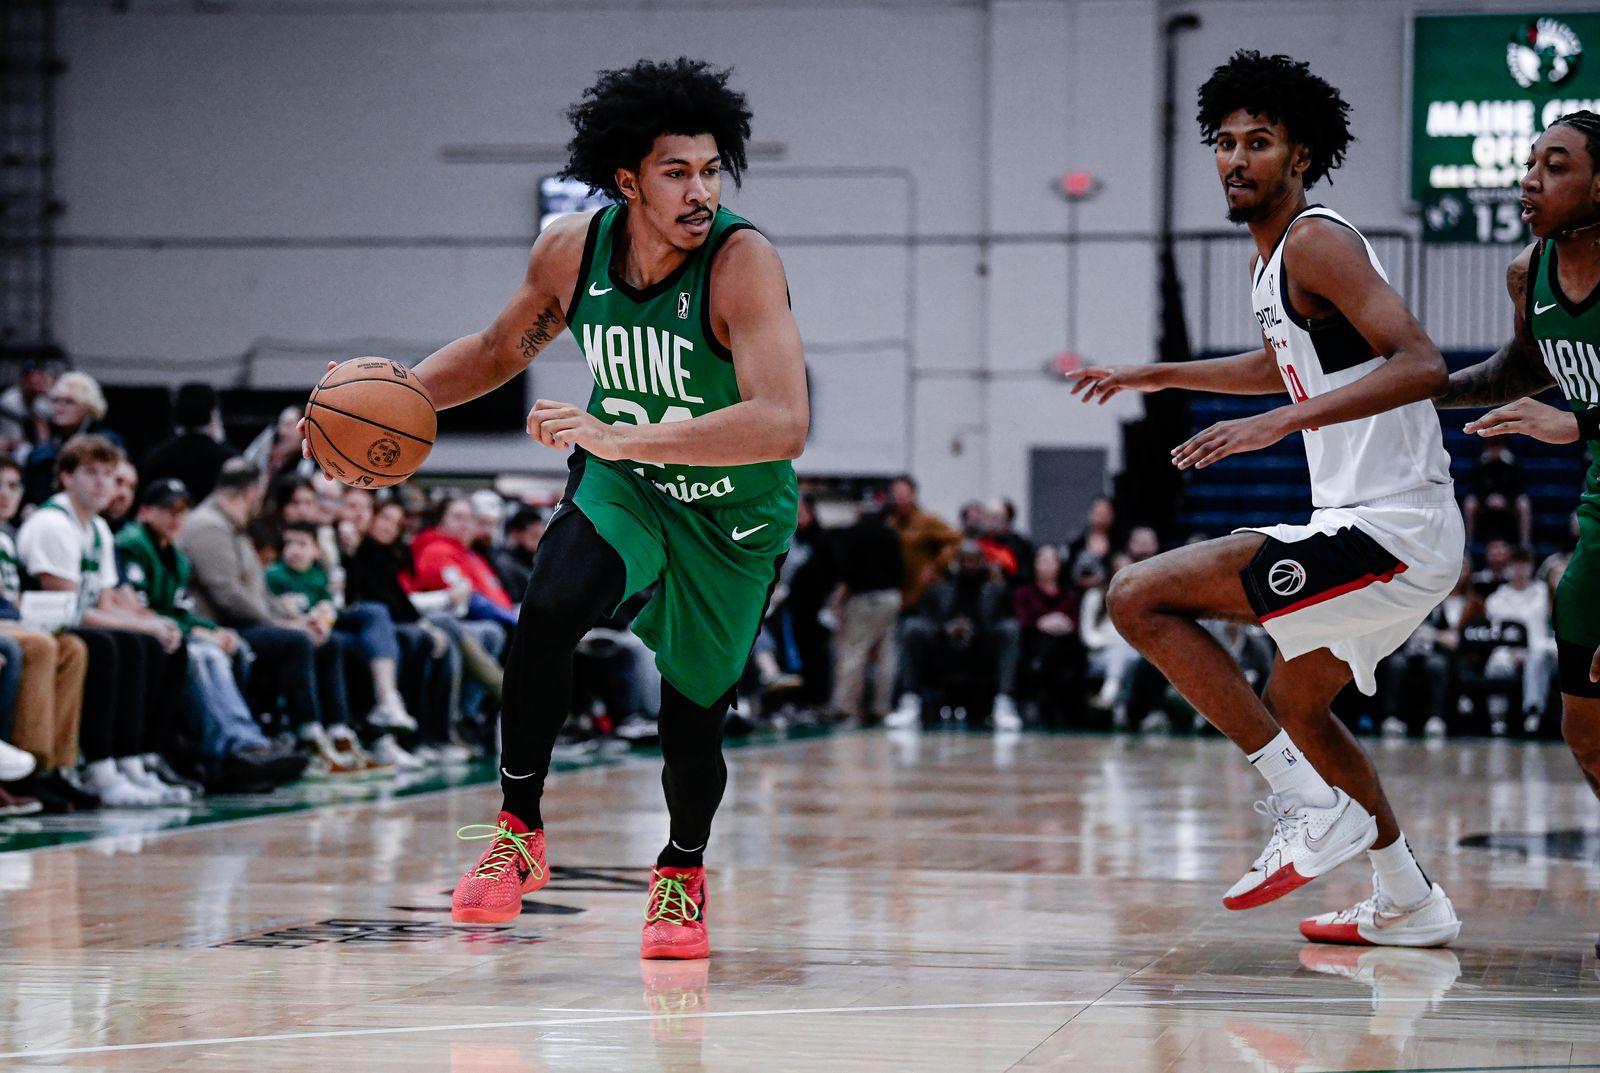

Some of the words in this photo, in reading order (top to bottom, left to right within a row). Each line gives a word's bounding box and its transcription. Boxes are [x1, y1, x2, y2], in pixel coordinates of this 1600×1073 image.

[1426, 99, 1536, 137] MAINE
[1472, 204, 1524, 243] 15
[582, 324, 704, 403] MAINE
